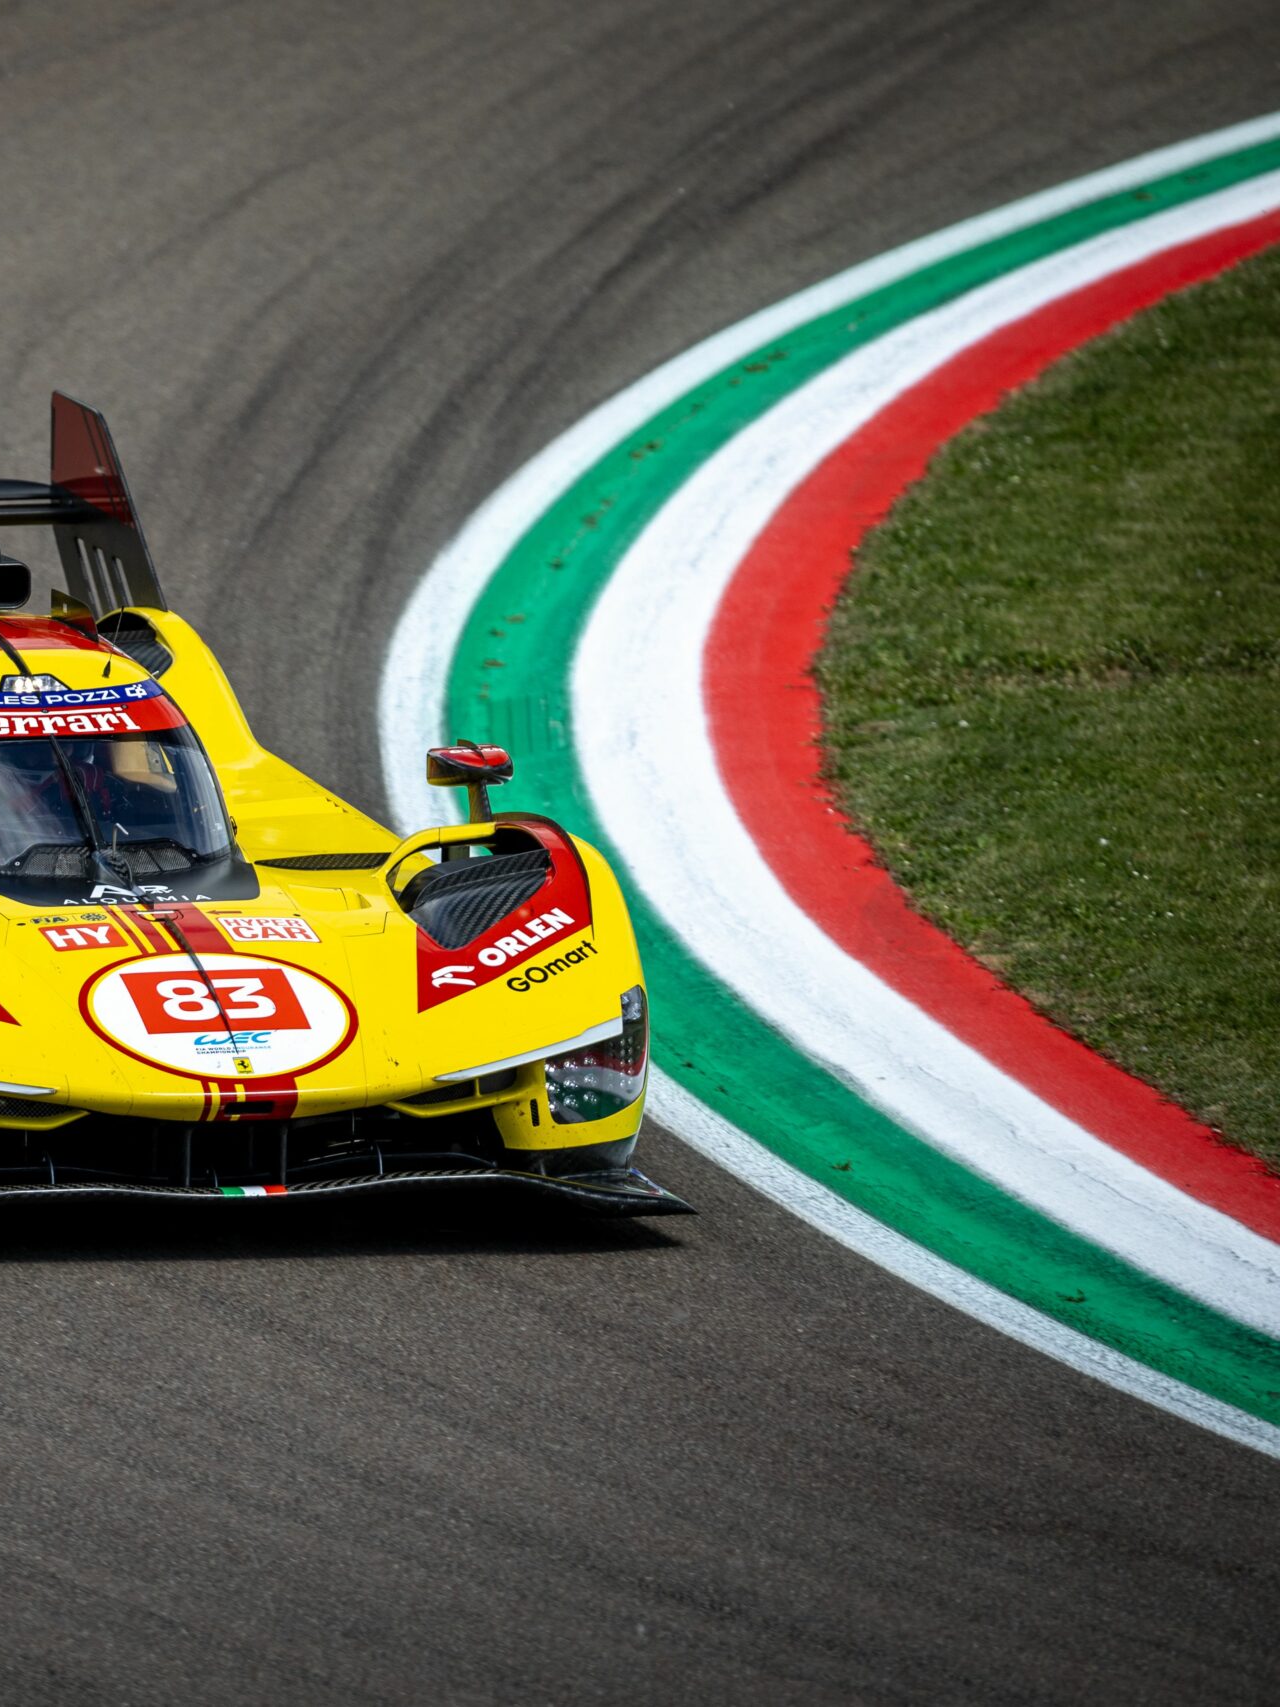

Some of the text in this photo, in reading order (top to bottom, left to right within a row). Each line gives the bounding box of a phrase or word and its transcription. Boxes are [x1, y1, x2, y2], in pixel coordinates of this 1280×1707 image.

[45, 689, 121, 704] POZZI
[32, 915, 67, 925] FIA
[223, 918, 303, 926] HYPER
[45, 925, 111, 947] HY
[232, 926, 313, 939] CAR
[478, 907, 575, 967] ORLEN
[506, 940, 598, 992] GOmart
[155, 977, 277, 1021] 83
[194, 1031, 272, 1046] WEC
